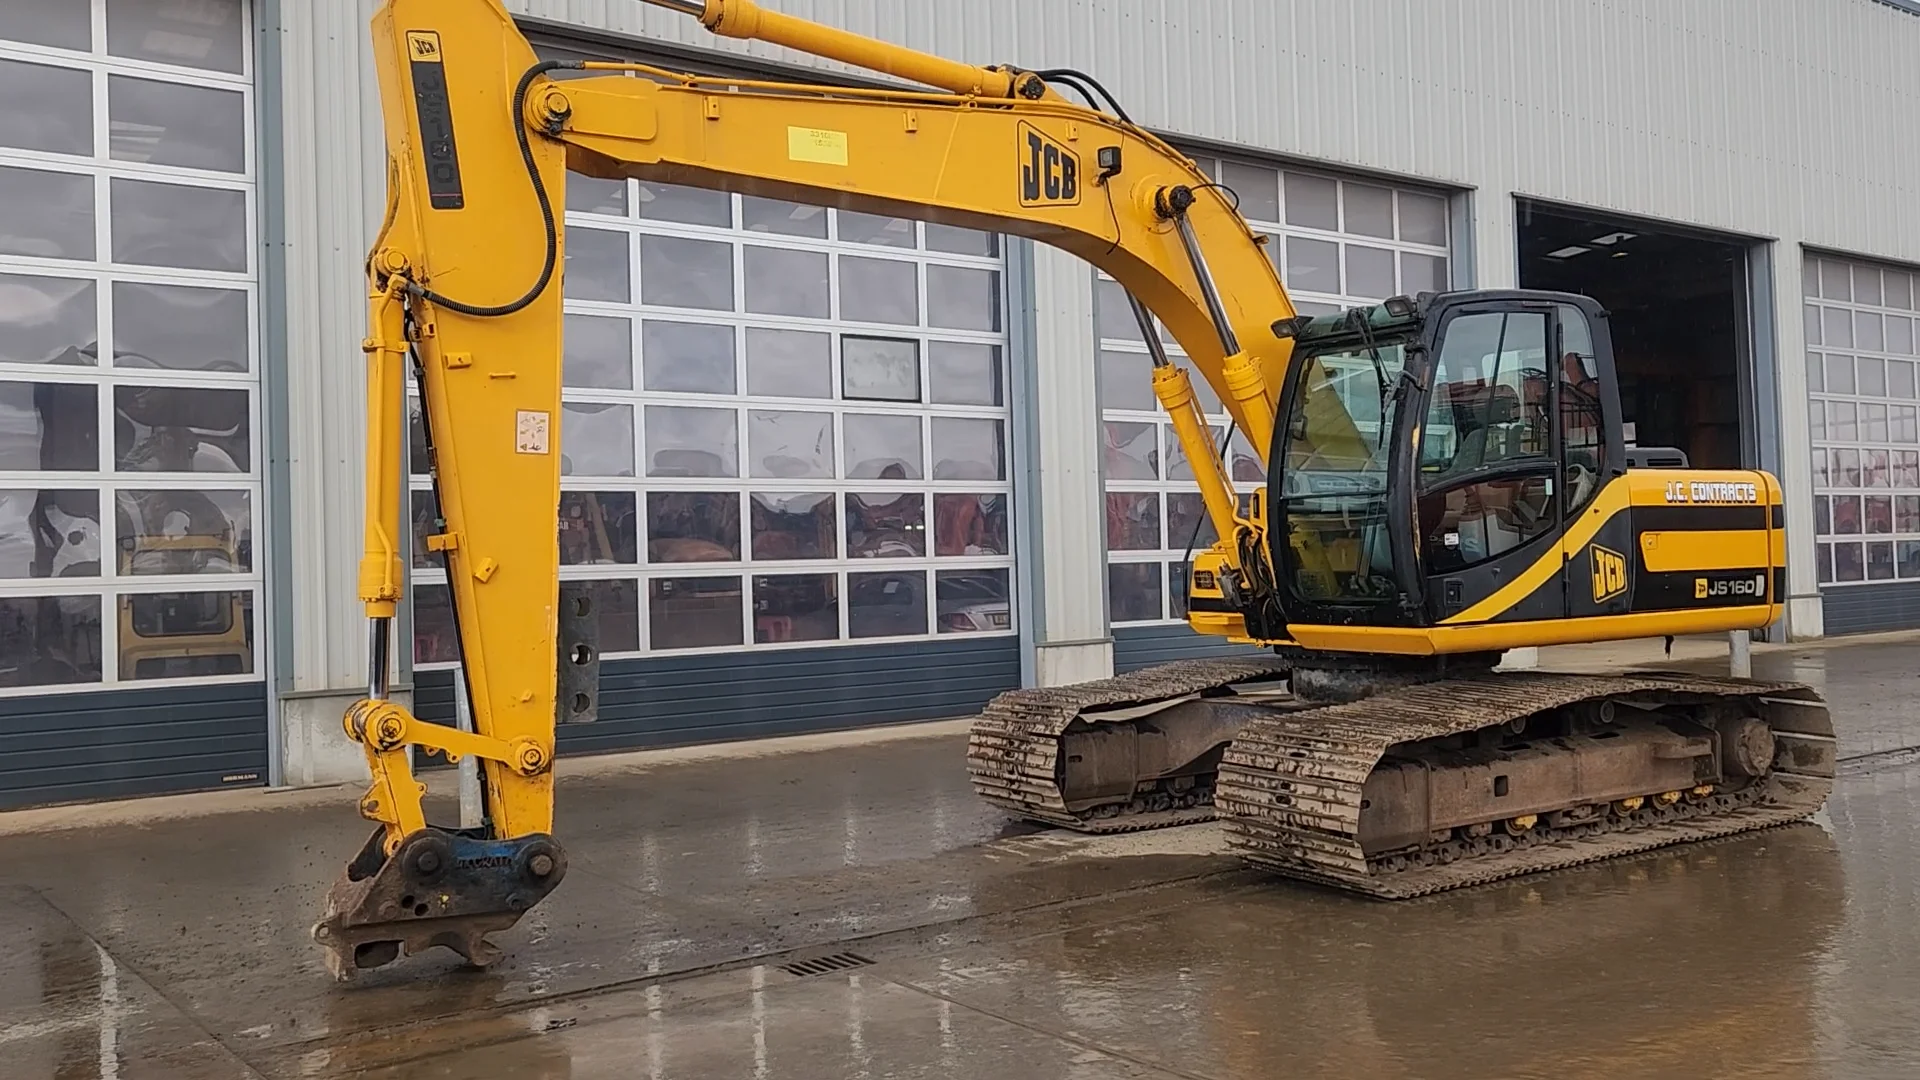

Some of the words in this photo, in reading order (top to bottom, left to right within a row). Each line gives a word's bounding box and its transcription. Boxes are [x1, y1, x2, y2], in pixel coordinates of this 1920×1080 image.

[1022, 130, 1077, 201] JCB
[1665, 481, 1688, 503] J.C.
[1690, 481, 1757, 503] CONTRACTS
[1594, 549, 1625, 598] JCB
[1708, 580, 1755, 596] JS160
